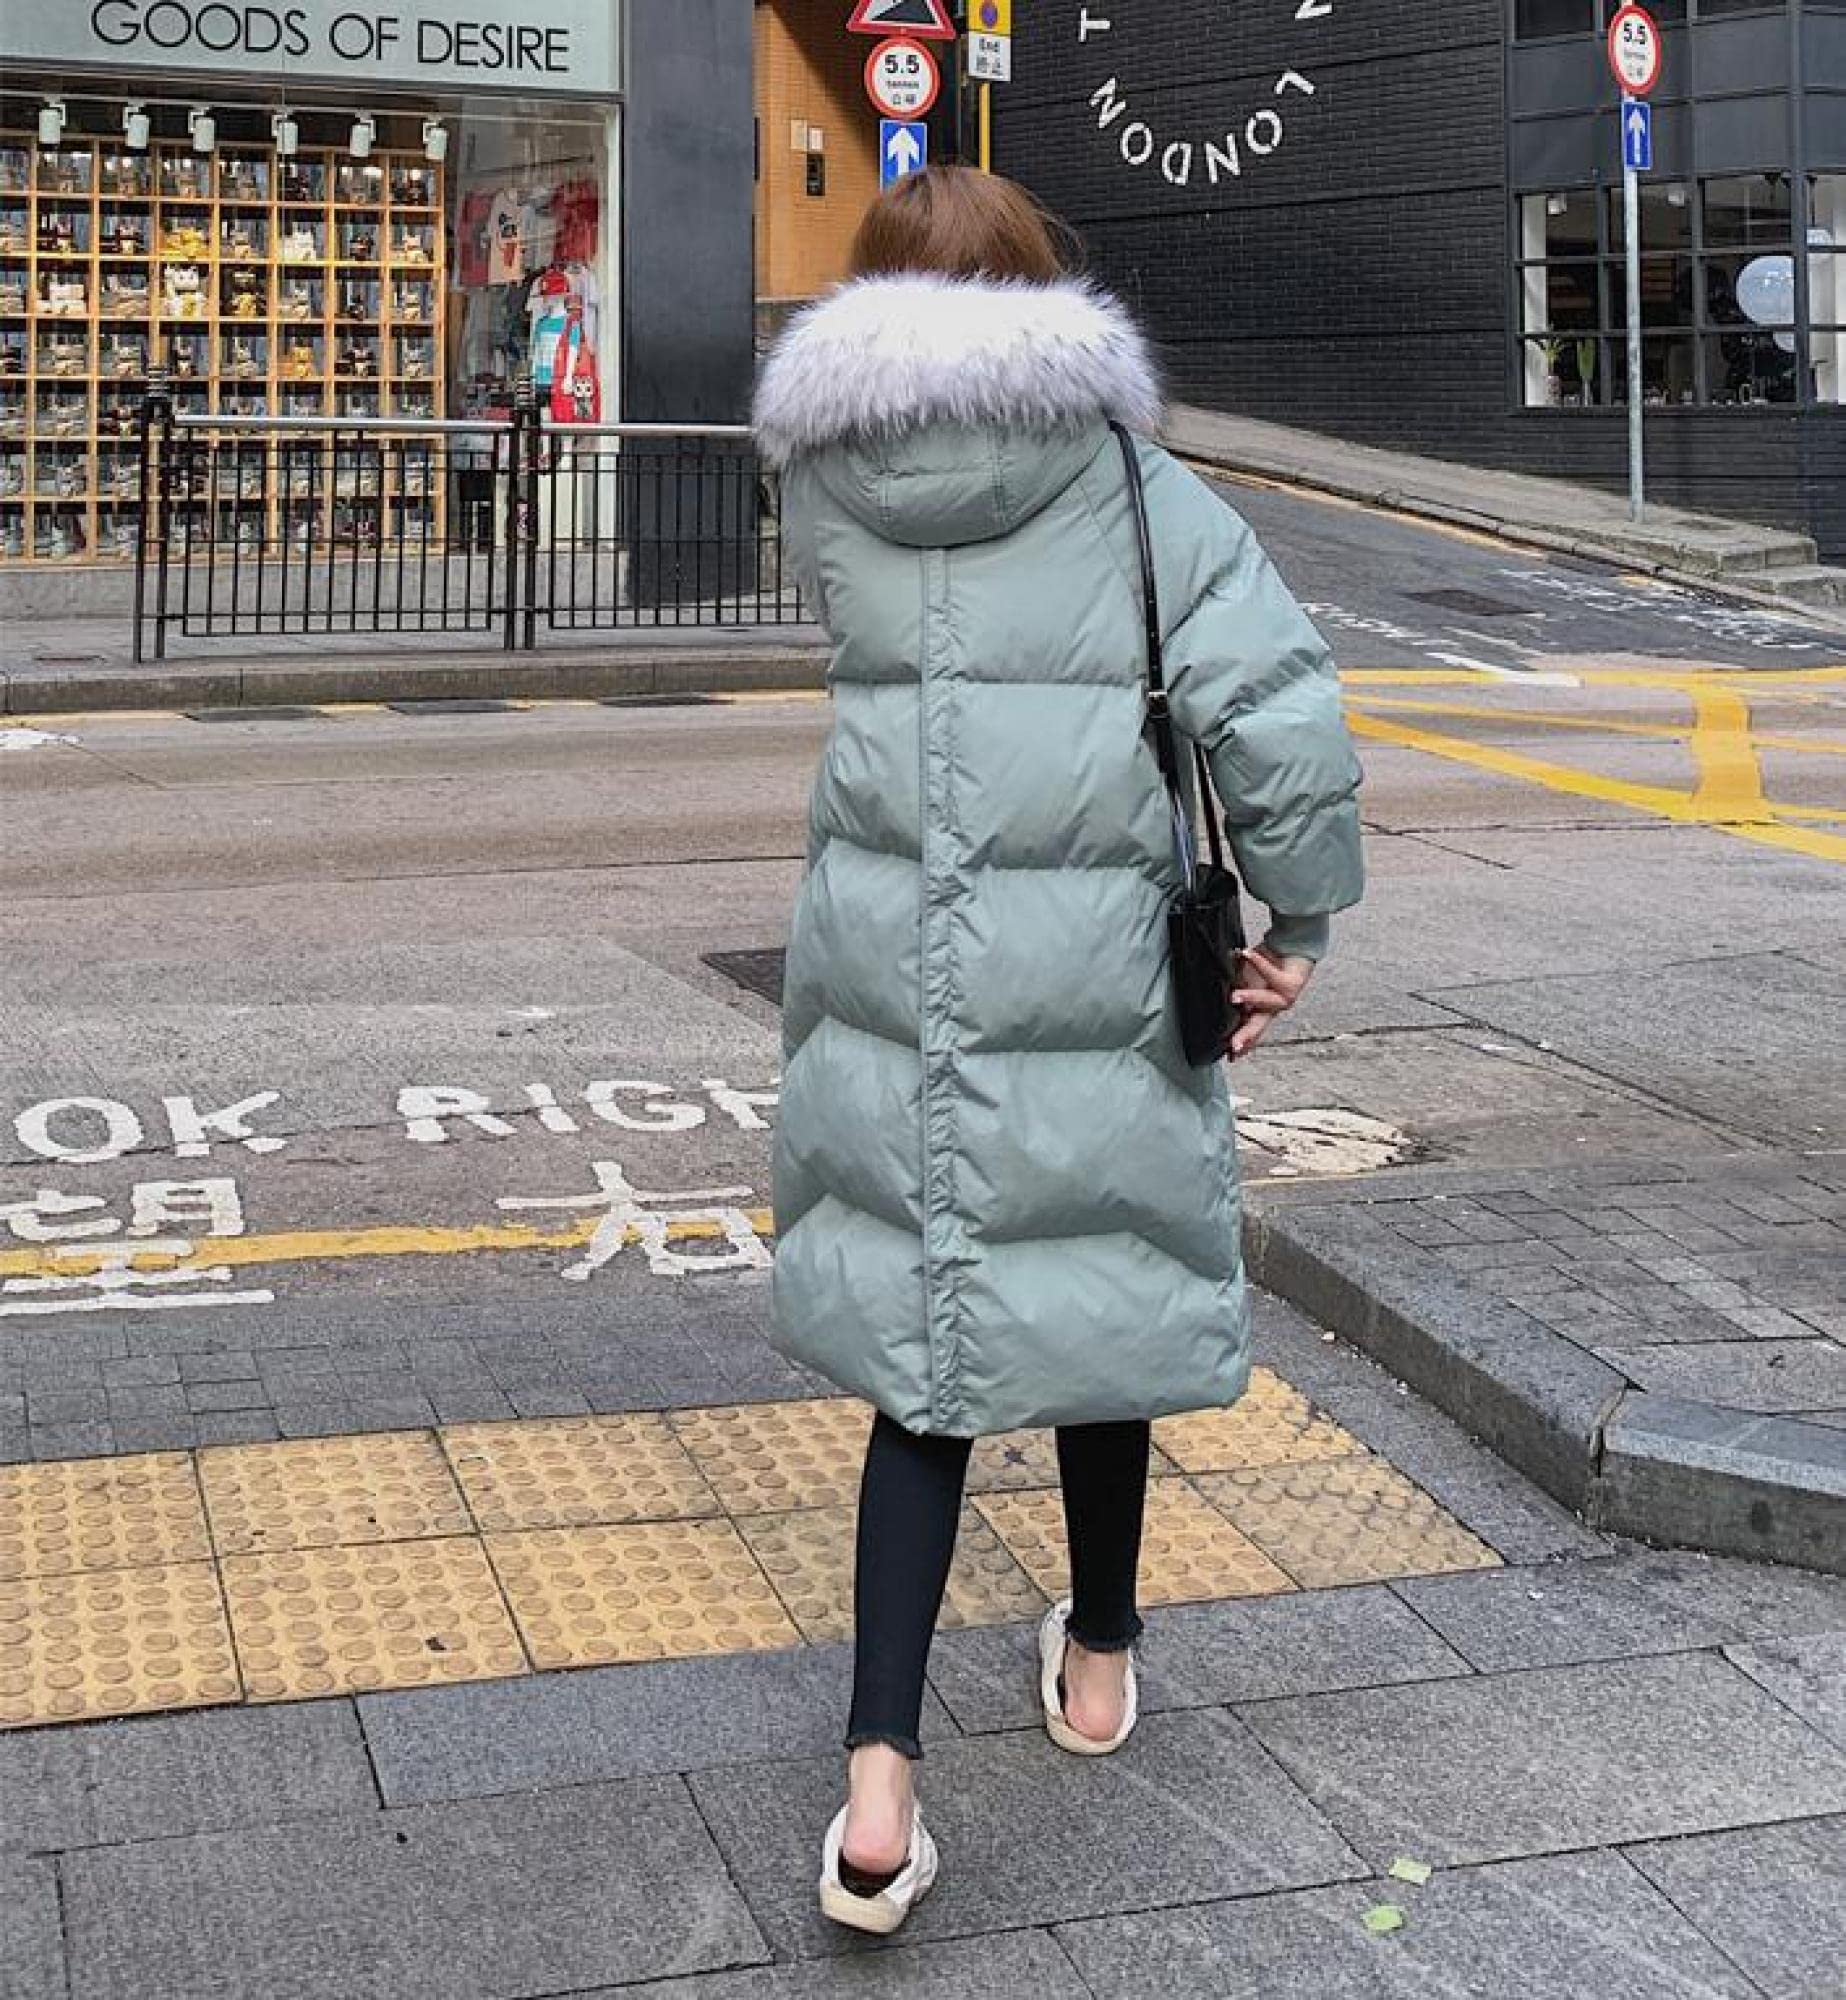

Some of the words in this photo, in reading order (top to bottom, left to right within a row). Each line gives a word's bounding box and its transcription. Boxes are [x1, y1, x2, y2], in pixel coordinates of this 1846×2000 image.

[91, 0, 309, 56] GOODS
[329, 13, 399, 60] OF
[417, 18, 569, 72] DESIRE
[1078, 8, 1110, 42] T
[885, 54, 920, 73] 5.5
[1089, 70, 1315, 186] LONDON
